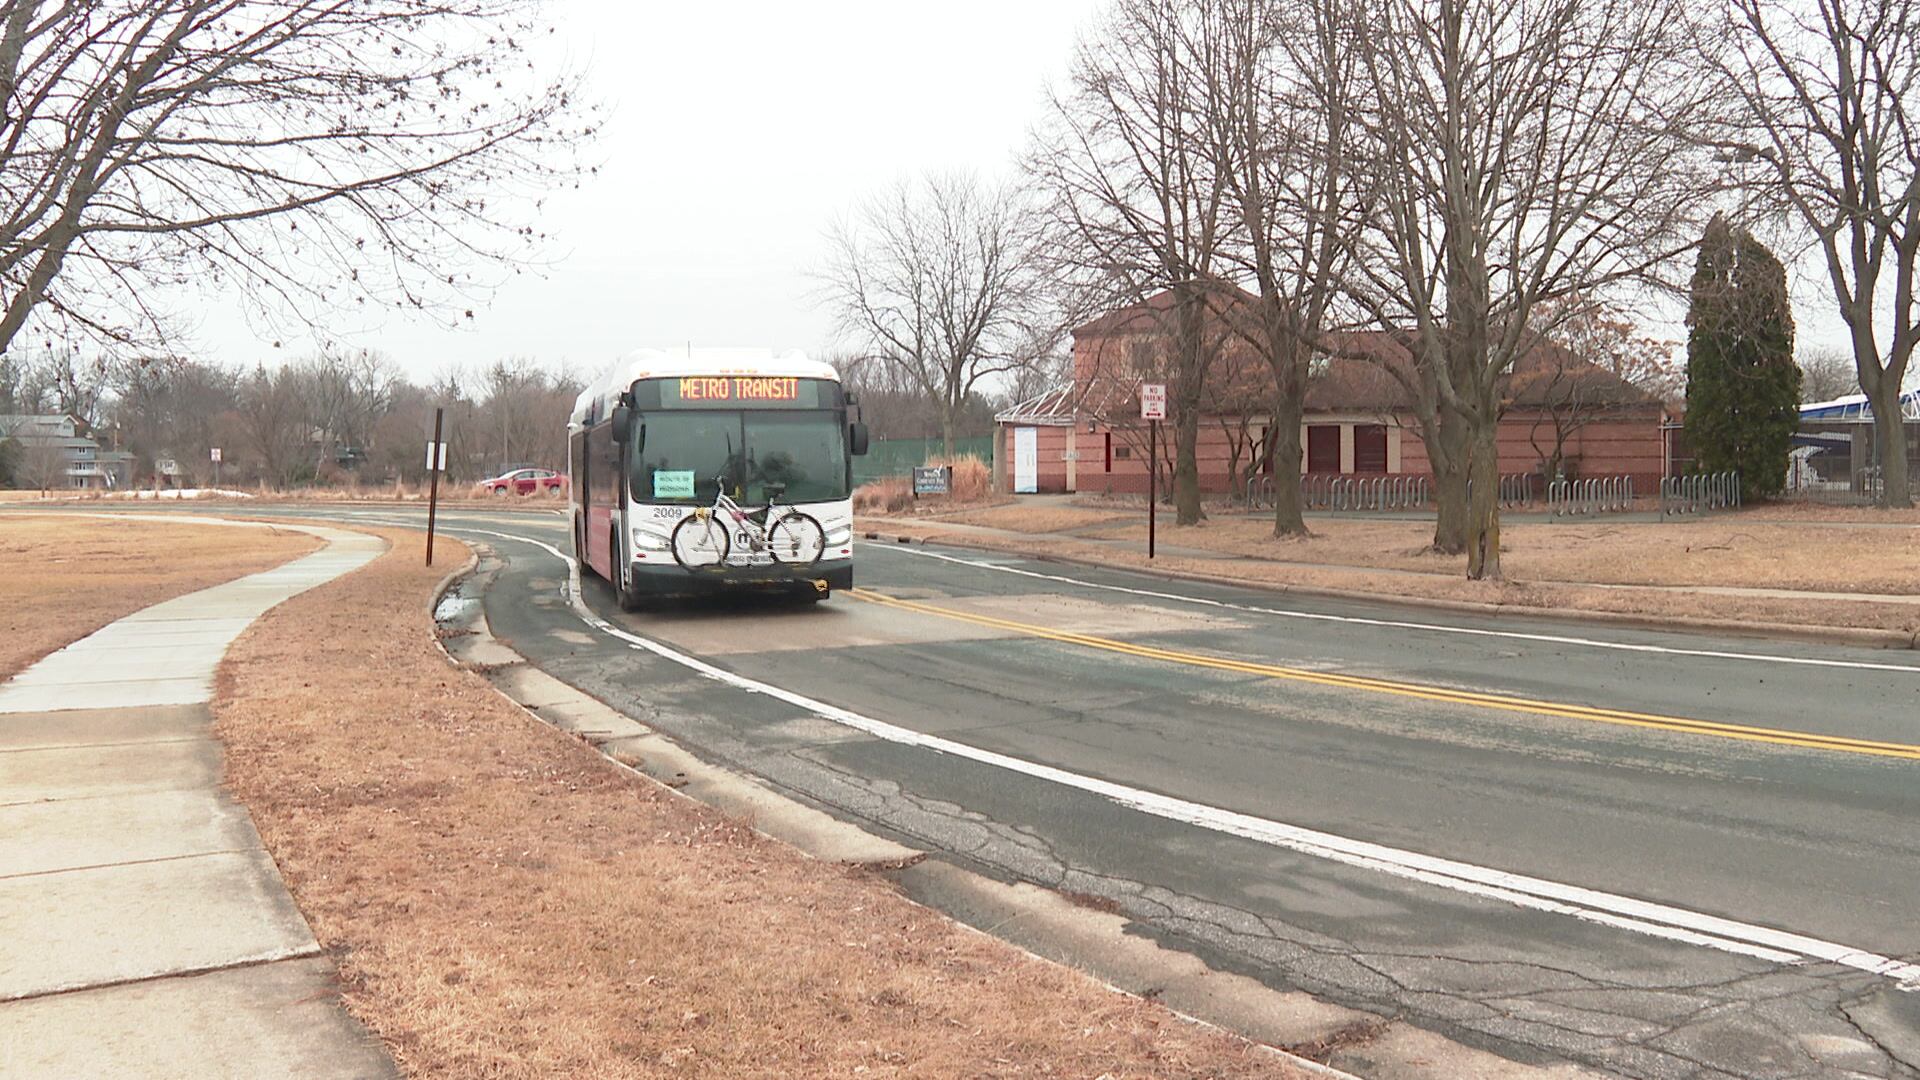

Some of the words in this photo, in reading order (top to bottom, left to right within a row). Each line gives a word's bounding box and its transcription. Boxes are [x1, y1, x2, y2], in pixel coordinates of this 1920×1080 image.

[679, 378, 729, 399] METRO
[733, 378, 798, 399] TRANSIT
[653, 507, 682, 519] 2009
